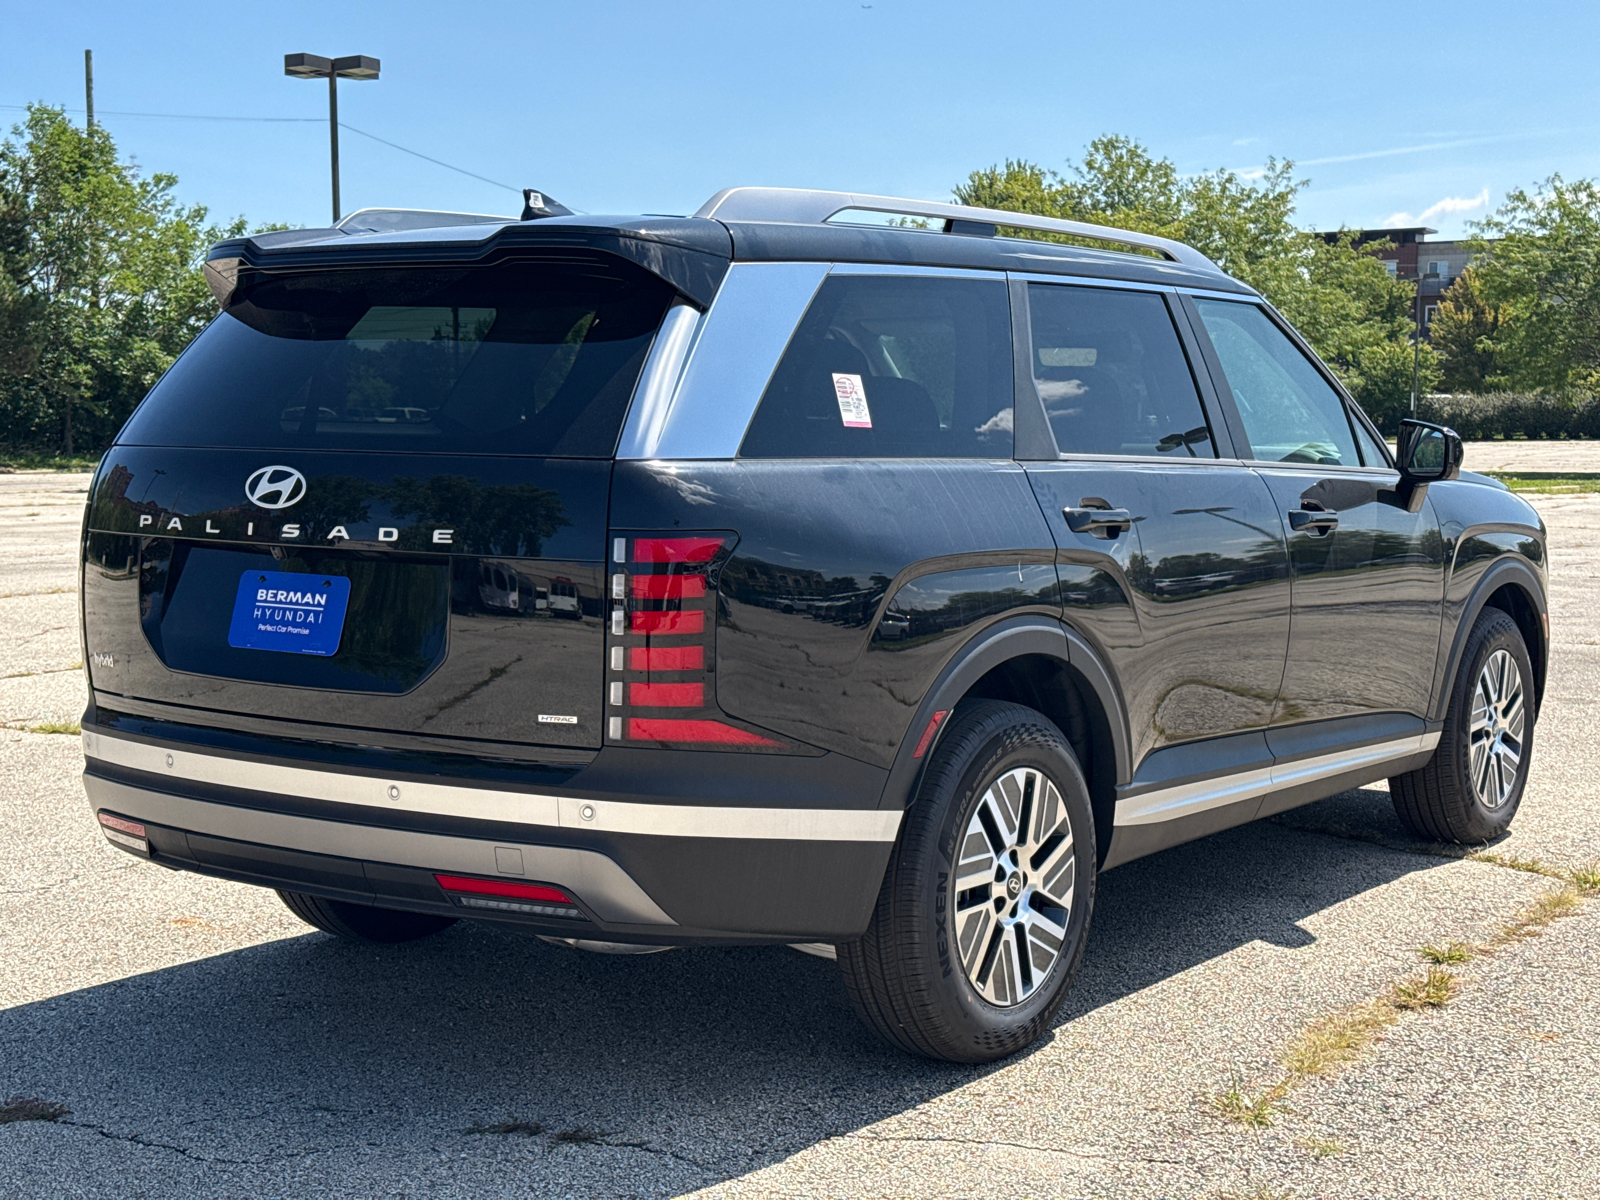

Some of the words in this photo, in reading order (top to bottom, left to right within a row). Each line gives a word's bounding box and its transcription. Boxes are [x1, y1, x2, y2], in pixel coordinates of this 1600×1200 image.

[138, 514, 454, 544] PALISADE
[256, 589, 327, 605] BERMAN
[253, 607, 323, 624] HYUNDAI
[257, 623, 277, 632] Perfect
[277, 625, 287, 633] Car
[287, 626, 310, 635] Promise
[935, 871, 953, 979] NEXEN
